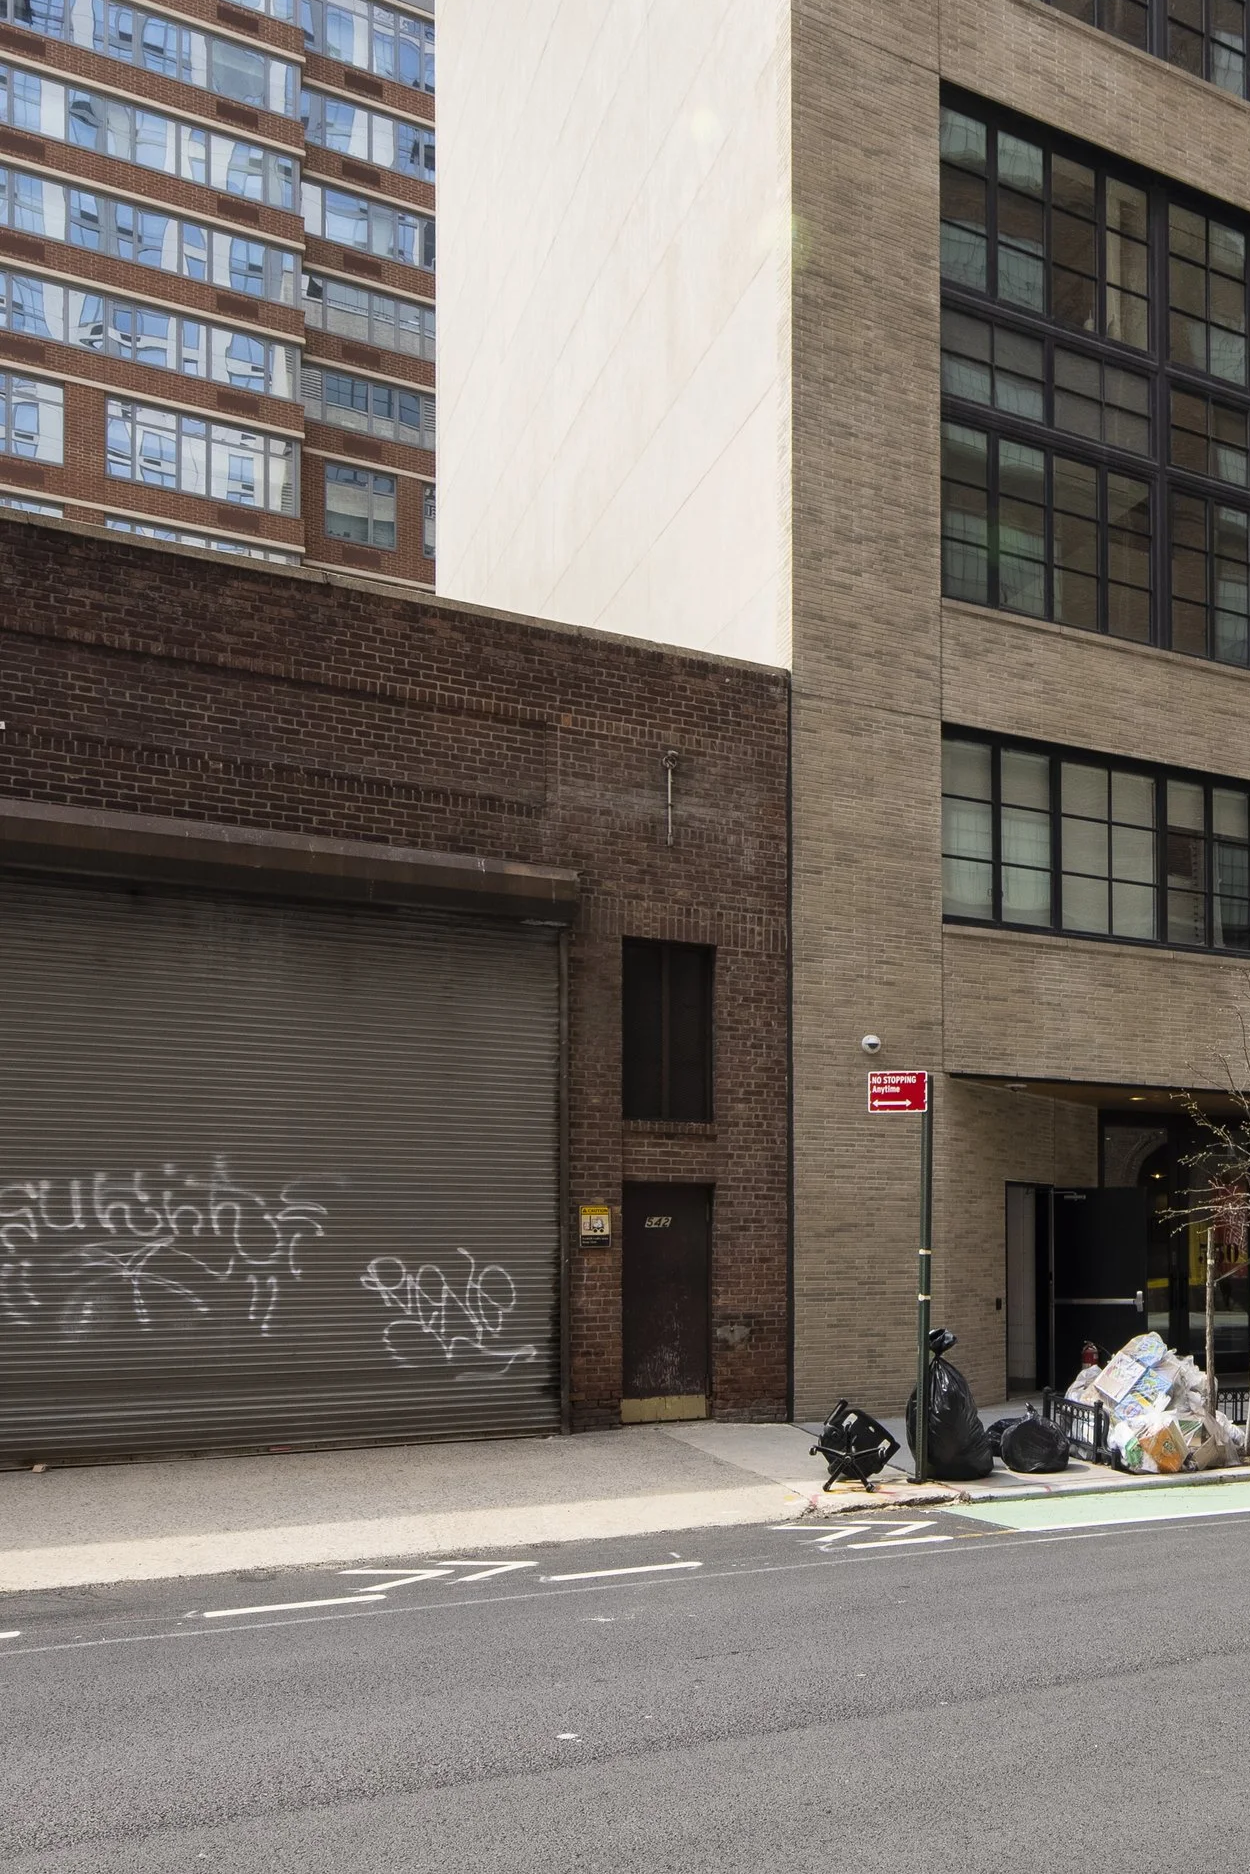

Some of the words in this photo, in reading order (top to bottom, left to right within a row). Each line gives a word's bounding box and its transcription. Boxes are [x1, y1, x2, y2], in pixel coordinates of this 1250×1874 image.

[871, 1076, 882, 1084] NO
[883, 1075, 917, 1084] STOPPING
[872, 1085, 901, 1094] Anytime
[645, 1217, 671, 1227] 542
